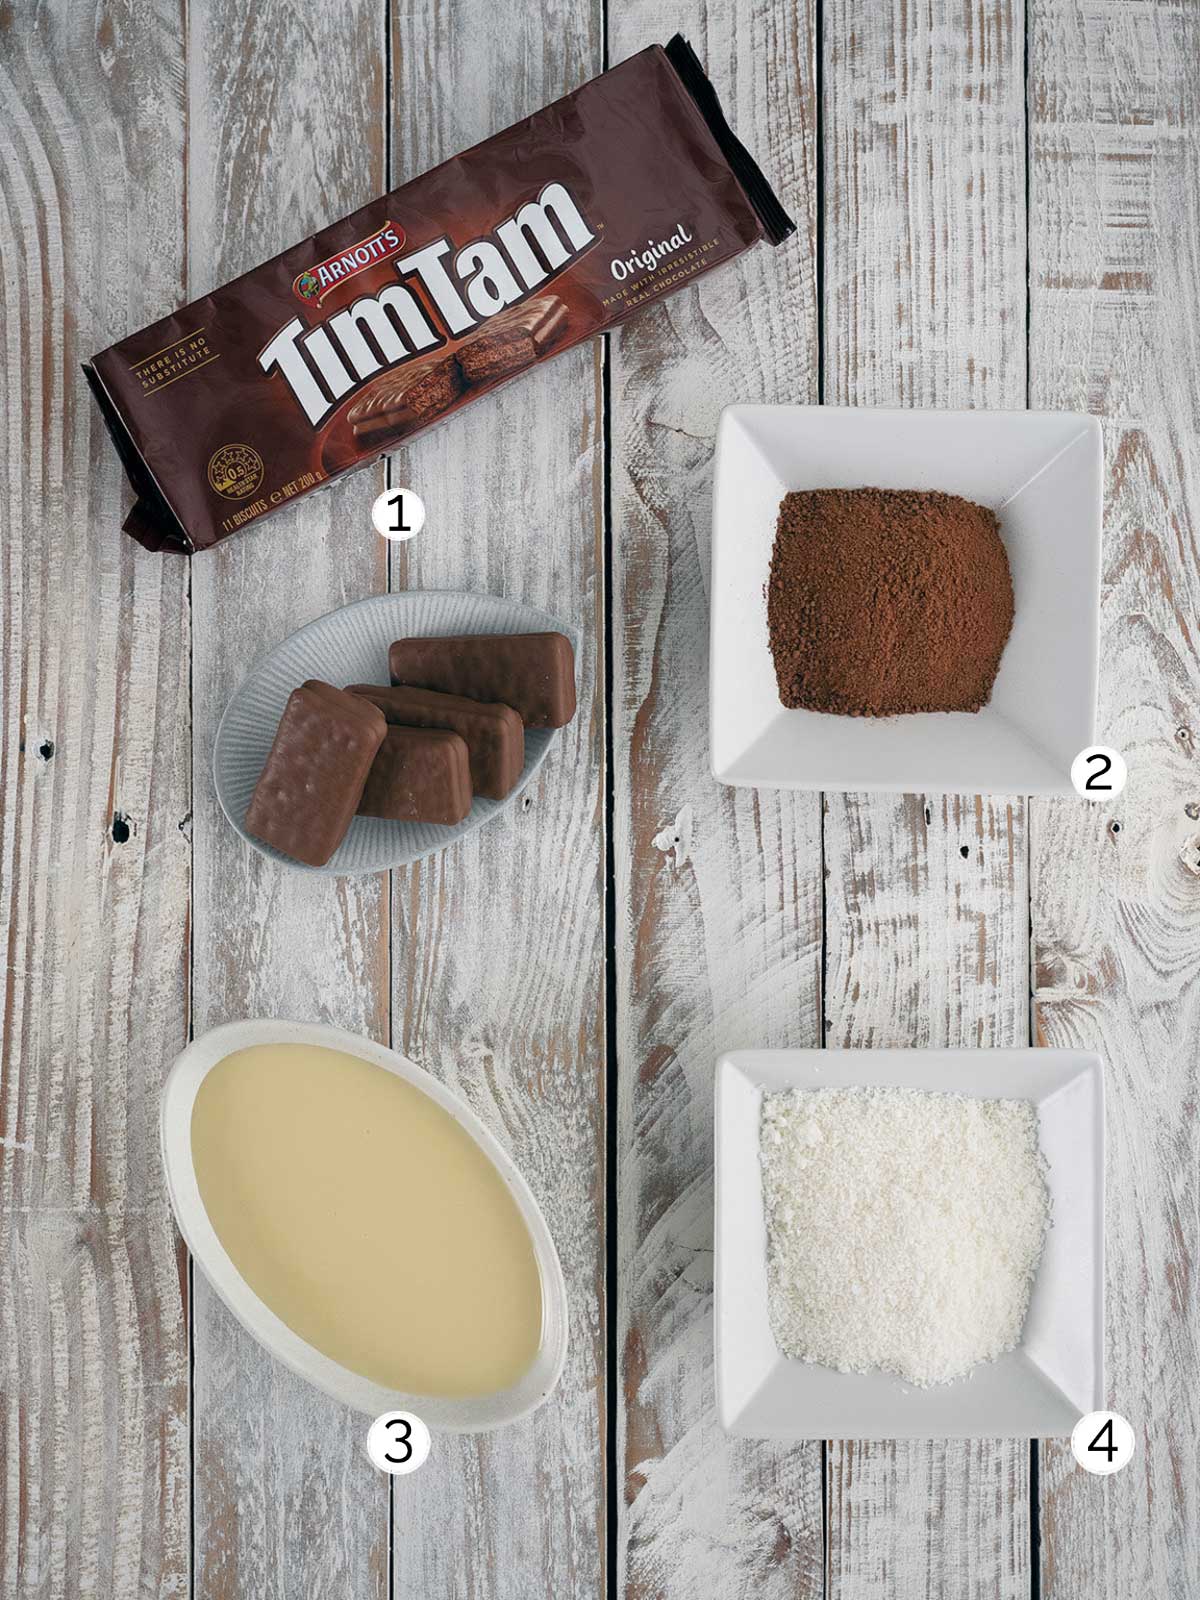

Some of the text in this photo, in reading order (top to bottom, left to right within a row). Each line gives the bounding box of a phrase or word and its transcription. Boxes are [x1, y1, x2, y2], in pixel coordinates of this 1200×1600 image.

[317, 229, 399, 288] ARNOTT'S
[602, 238, 720, 307] MADE WITH IRRESISTIBLE
[610, 223, 692, 281] Original
[625, 258, 708, 307] REAL CHOCOLATE
[135, 337, 206, 379] THERE IS NO
[141, 346, 211, 389] SUBSTITUTE
[222, 519, 233, 532] 11
[232, 498, 268, 525] BISCUITS
[281, 481, 299, 497] NET
[297, 472, 315, 489] 200
